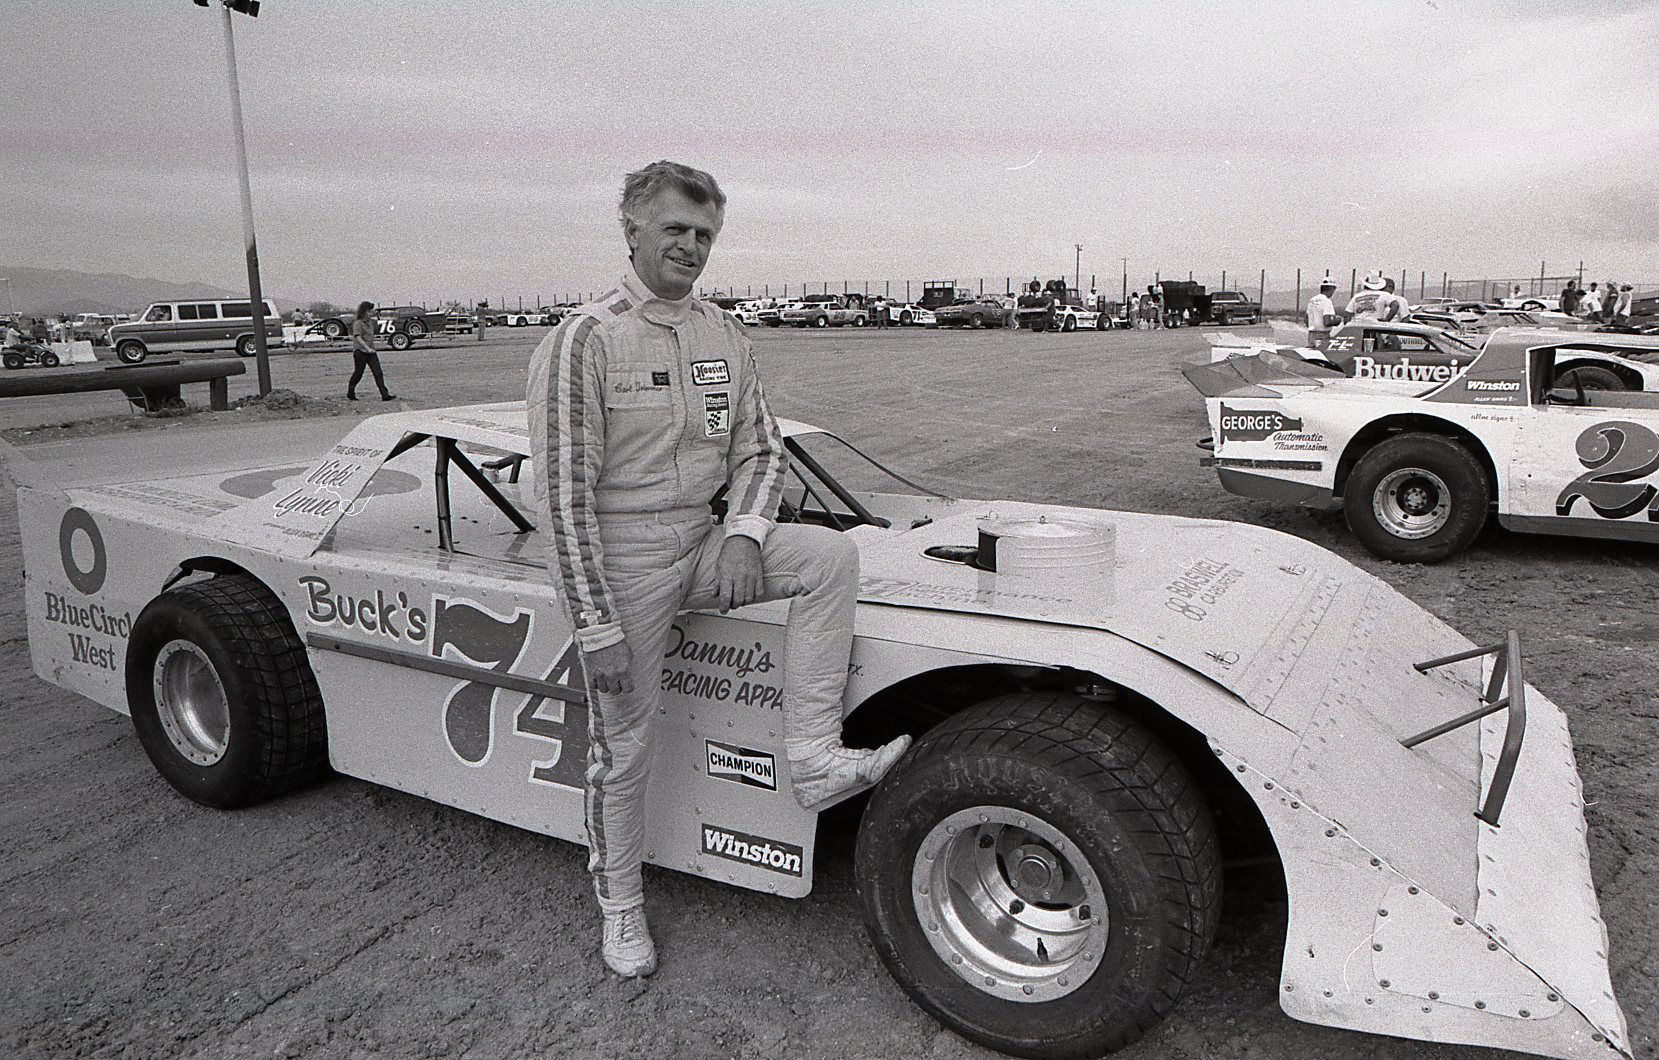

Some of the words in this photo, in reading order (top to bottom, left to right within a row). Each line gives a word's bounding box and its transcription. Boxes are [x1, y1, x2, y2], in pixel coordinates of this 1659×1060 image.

[377, 319, 396, 334] 76
[695, 364, 726, 379] Hoosier
[1467, 380, 1520, 391] Winston
[1222, 414, 1283, 430] GEORGE'S
[1273, 432, 1323, 442] Automatic
[369, 449, 384, 458] OF
[1274, 442, 1329, 451] Transmission
[1555, 420, 1659, 522] 2
[273, 487, 340, 518] Lynne
[45, 591, 132, 639] BlueCircl
[299, 575, 427, 641] Buck's
[68, 633, 116, 671] West
[664, 624, 775, 678] Danny's
[429, 593, 591, 795] 74
[661, 669, 731, 701] RACING
[734, 681, 783, 711] APPA
[710, 752, 772, 778] CHAMPION
[704, 828, 801, 872] Winston
